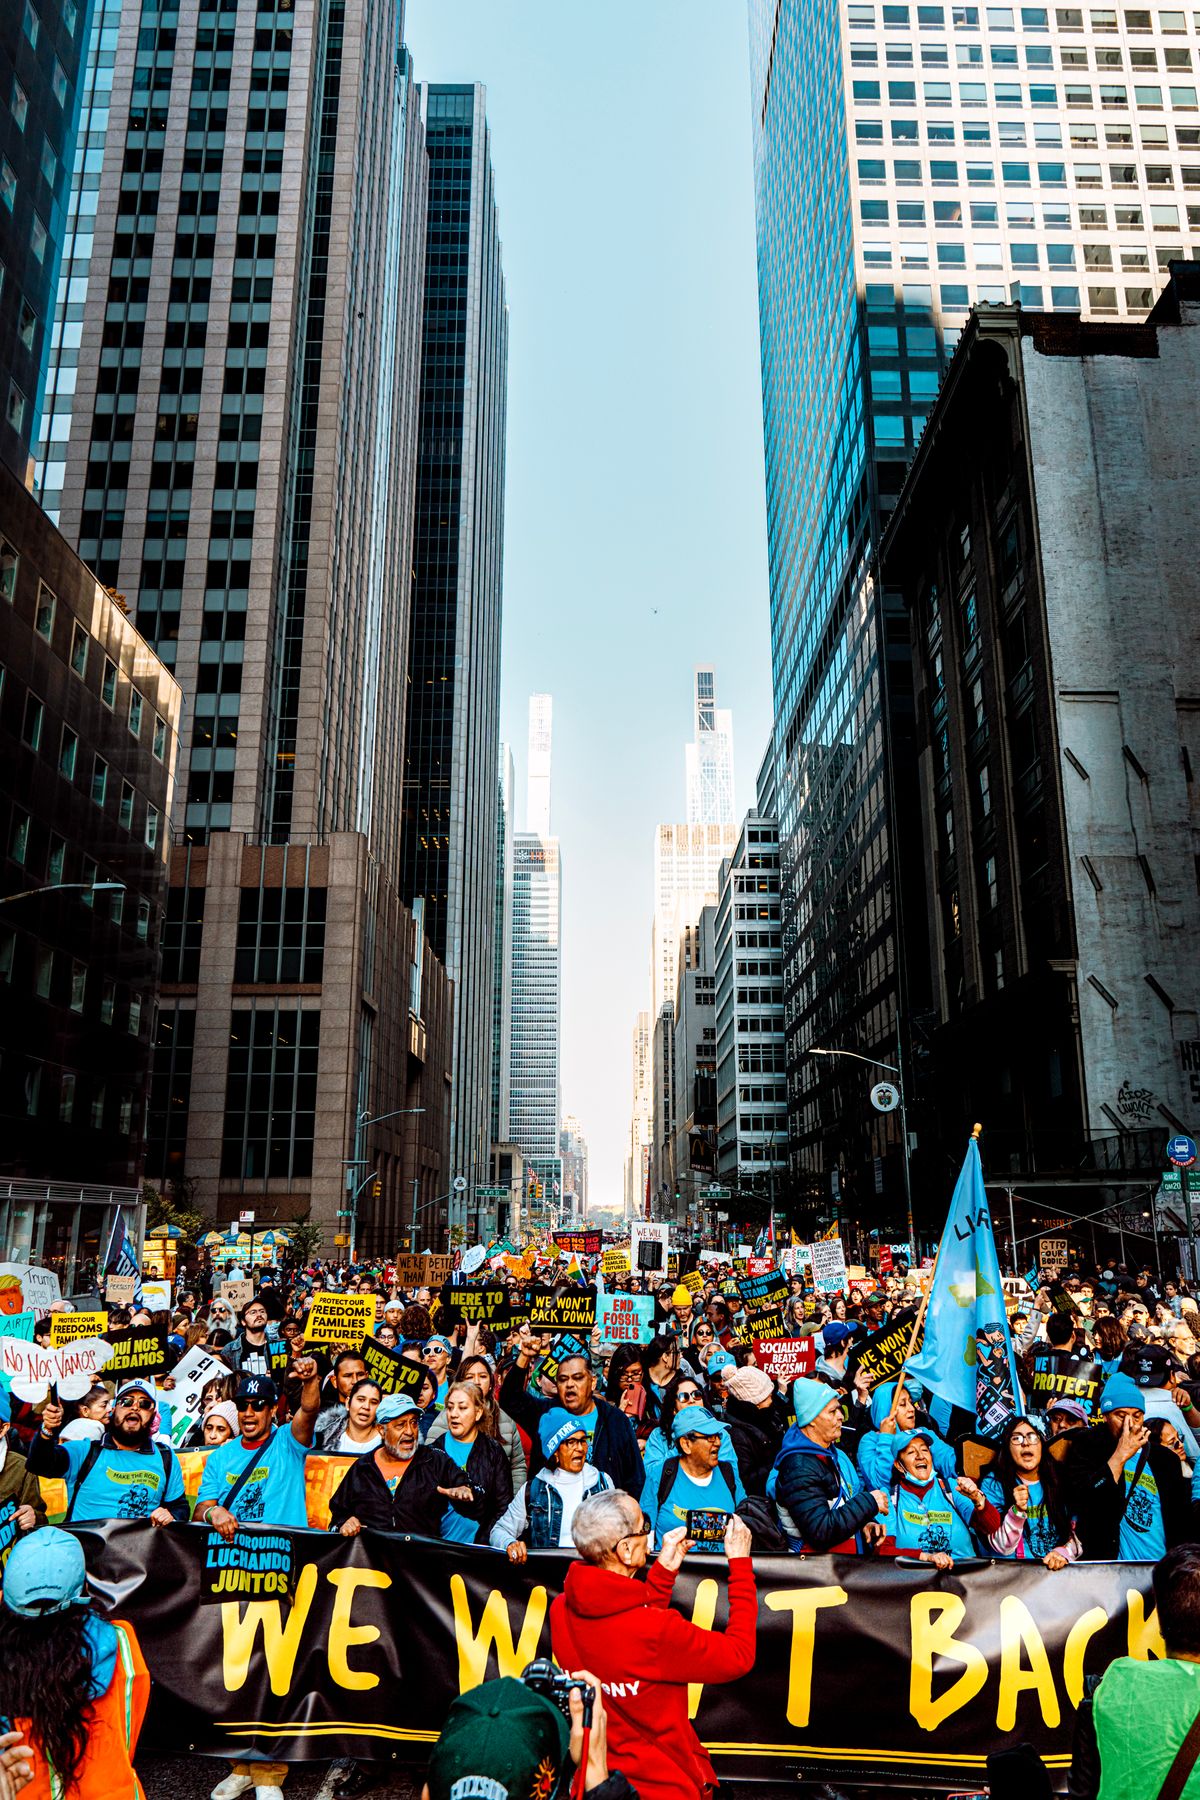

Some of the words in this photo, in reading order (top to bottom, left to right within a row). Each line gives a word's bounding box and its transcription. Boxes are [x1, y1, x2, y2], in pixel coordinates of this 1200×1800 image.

[1163, 1172, 1178, 1181] QM2
[1164, 1182, 1181, 1190] QM20
[636, 1228, 648, 1236] WE
[1041, 1240, 1066, 1250] GTFO
[399, 1257, 424, 1270] WE'RE
[429, 1257, 454, 1270] BETTE
[24, 1268, 58, 1291] Trump
[403, 1271, 425, 1282] THAN
[738, 1281, 752, 1289] NEW
[752, 1271, 780, 1286] YORKERS
[450, 1292, 482, 1305] HERE
[486, 1292, 504, 1304] TO
[742, 1285, 768, 1299] STAND
[319, 1297, 348, 1305] PROTECT
[536, 1295, 551, 1308] WE
[556, 1296, 592, 1310] WON'T
[613, 1298, 634, 1312] END
[312, 1305, 372, 1316] FREEDOMS
[460, 1305, 495, 1320] STAY
[530, 1309, 559, 1324] BACK
[562, 1310, 595, 1325] DOWN
[313, 1317, 365, 1328] FAMILIES
[604, 1312, 641, 1326] FOSSIL
[734, 1324, 748, 1336] WE
[750, 1315, 778, 1332] WON'T
[54, 1324, 102, 1333] FREEDOMS
[312, 1328, 364, 1340] FUTURES
[604, 1326, 639, 1340] FUELS
[739, 1332, 755, 1345] ACK
[759, 1325, 784, 1340] DOWN
[112, 1338, 132, 1357] QUÍ
[134, 1337, 159, 1354] NOS
[269, 1341, 286, 1354] WE
[561, 1333, 582, 1353] NEW
[760, 1341, 808, 1353] SOCIALISM
[857, 1349, 877, 1369] WE
[876, 1321, 914, 1355] WON'T
[5, 1345, 23, 1372] NO
[552, 1345, 570, 1362] ST
[772, 1353, 797, 1363] BEATS
[364, 1346, 399, 1376] HERE
[399, 1365, 420, 1384] TO
[542, 1357, 559, 1377] TO
[764, 1362, 807, 1375] FASCISM!
[862, 1357, 896, 1380] ACK
[1035, 1356, 1048, 1371] WE
[247, 1380, 259, 1393] NY
[368, 1367, 406, 1394] STAY
[1033, 1372, 1098, 1398] PROTECT
[546, 1433, 561, 1454] NEW
[558, 1420, 576, 1439] YORK
[144, 1473, 159, 1482] ROAD
[206, 1548, 291, 1573] LUCHANDO
[211, 1569, 288, 1593] JUNTOS
[221, 1563, 392, 1696] WE
